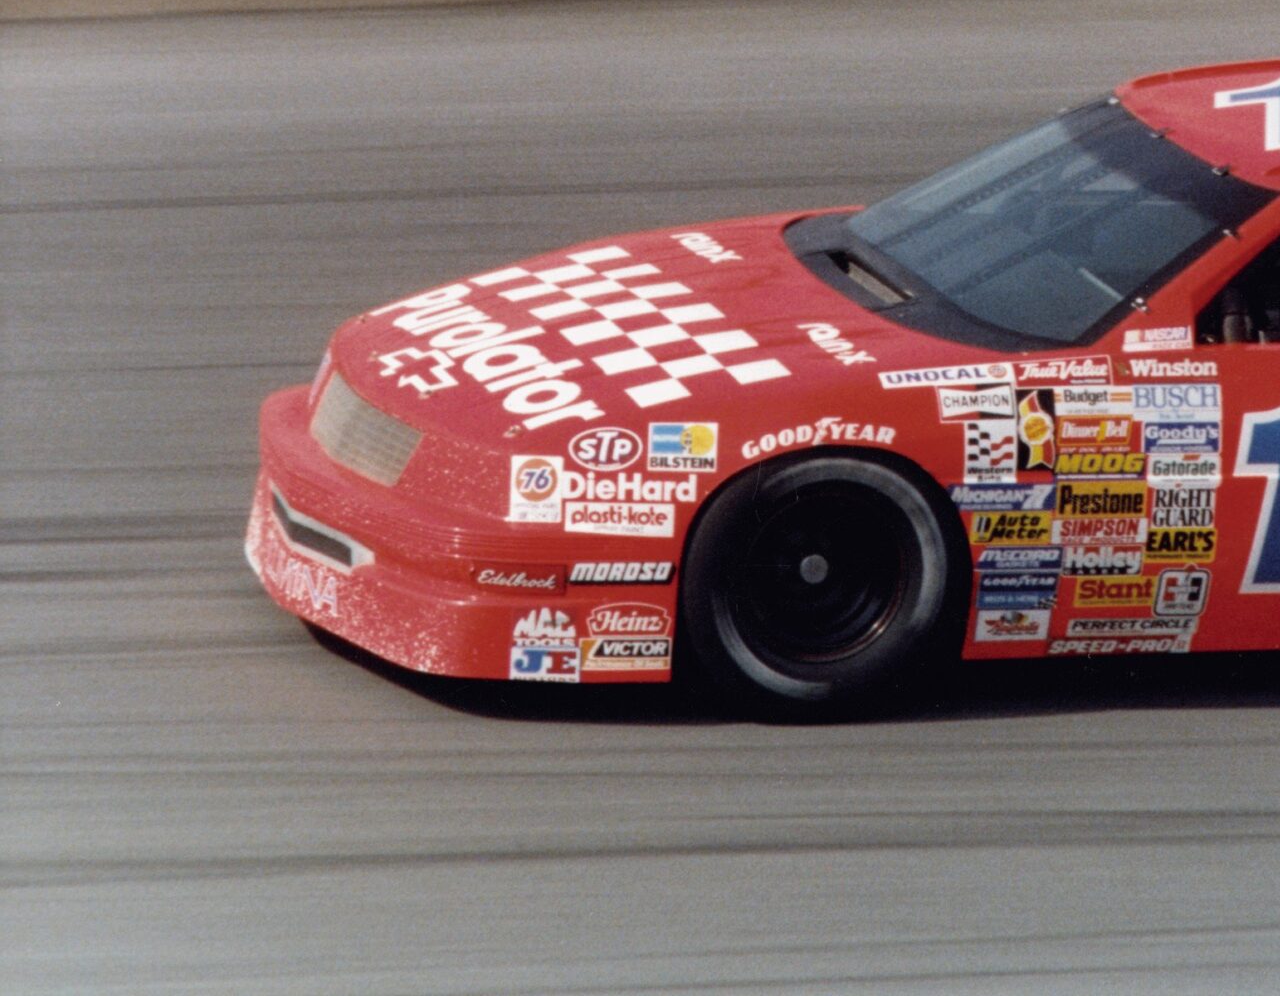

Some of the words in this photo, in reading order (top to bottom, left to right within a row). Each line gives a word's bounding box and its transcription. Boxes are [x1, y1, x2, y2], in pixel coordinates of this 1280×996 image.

[370, 284, 606, 430] Purolator
[885, 367, 987, 385] UNOCAL
[1048, 358, 1109, 380] Value
[1130, 358, 1218, 377] Winston
[943, 394, 1009, 409] CHAMPION
[1063, 389, 1109, 405] Budget
[1134, 386, 1219, 409] BUSCH
[1145, 425, 1219, 442] Goody's
[649, 457, 715, 469] BILSTEIN
[1055, 453, 1146, 474] MOOG
[1152, 460, 1217, 476] Gatorade
[520, 468, 552, 492] 76
[562, 471, 698, 502] DieHard
[1058, 484, 1144, 515] Prestone
[1155, 488, 1214, 508] RIGHT
[570, 505, 668, 527] plasti-kote
[996, 513, 1041, 527] Auto
[1153, 508, 1214, 527] GUARD
[990, 527, 1049, 540] Meter
[1060, 519, 1140, 537] SIMPSON
[1146, 530, 1215, 552] EARL'S
[1065, 546, 1142, 574] Holley
[477, 569, 556, 589] Edelbrock
[1078, 579, 1153, 600] Stant
[513, 607, 576, 637] MAC
[591, 610, 663, 632] Heinz
[1071, 619, 1139, 631] PERFECT
[1140, 618, 1193, 630] CIRCLE
[514, 637, 576, 647] TOOLS
[602, 641, 668, 656] VICTOR
[1049, 638, 1173, 654] SPEED-PRO
[514, 649, 577, 674] JE
